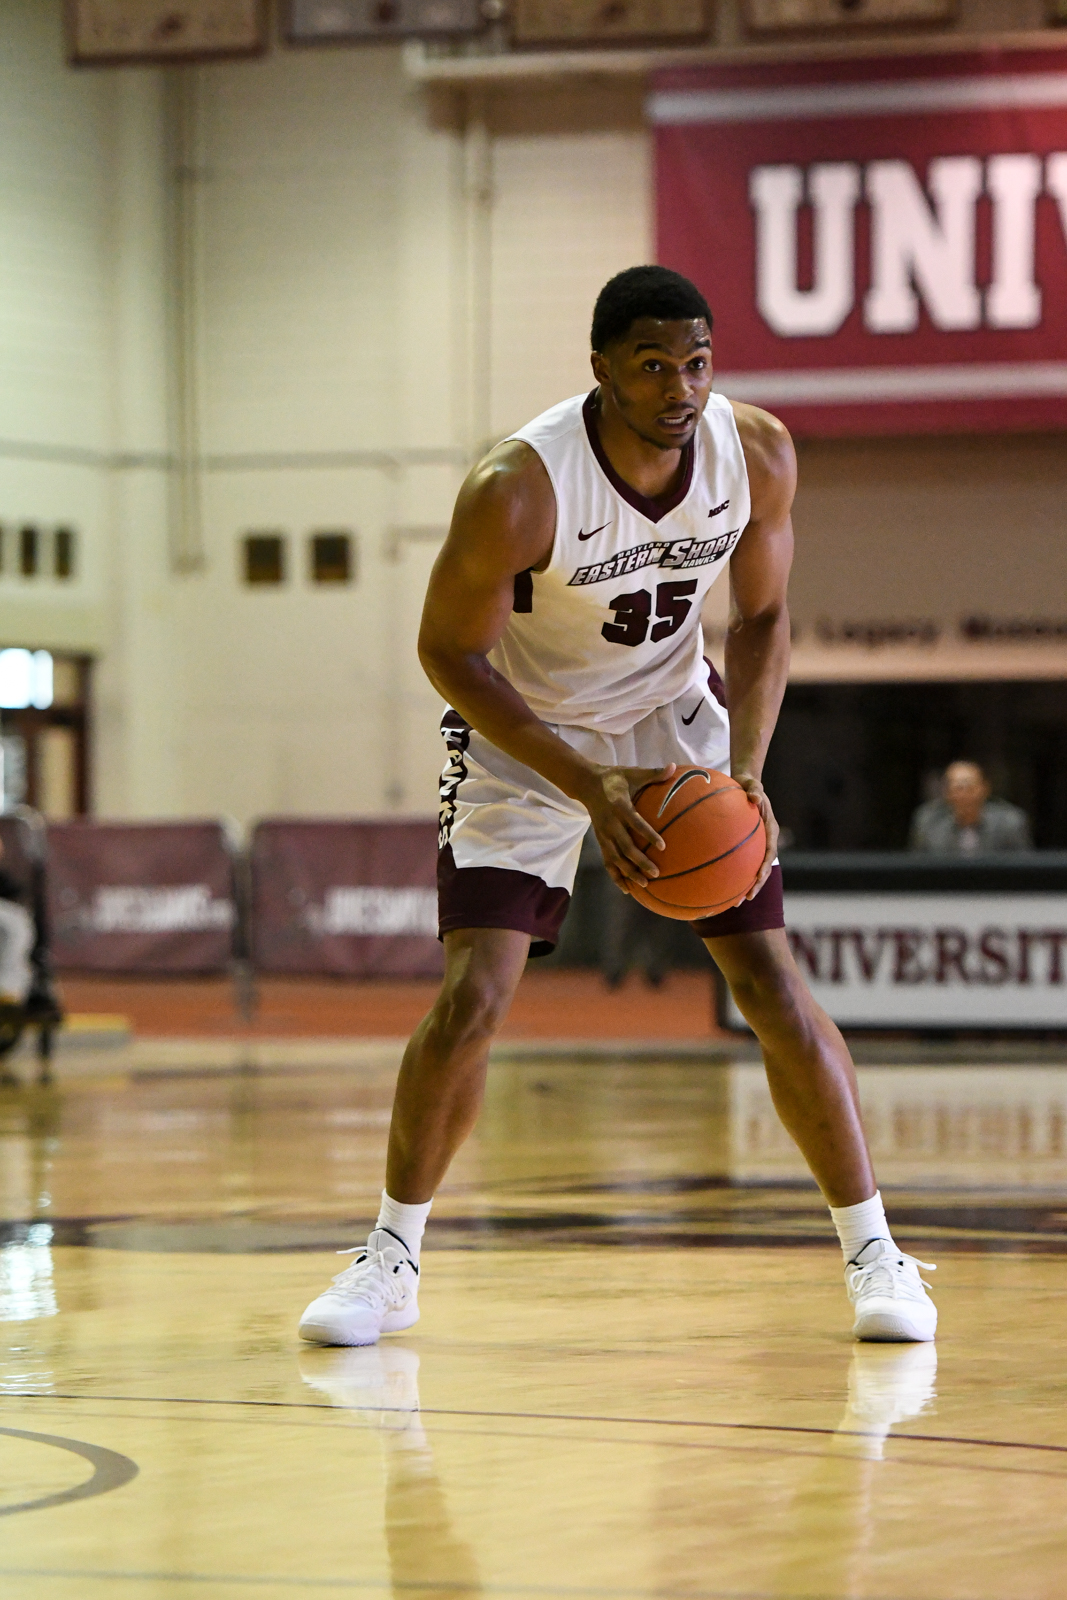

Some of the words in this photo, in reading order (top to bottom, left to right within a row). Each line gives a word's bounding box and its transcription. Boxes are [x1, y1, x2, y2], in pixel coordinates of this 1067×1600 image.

[749, 152, 1067, 338] UNI
[569, 547, 666, 586] EASTERN
[617, 542, 670, 559] MARYLAND
[681, 553, 717, 569] HAWKS
[601, 579, 698, 647] 35
